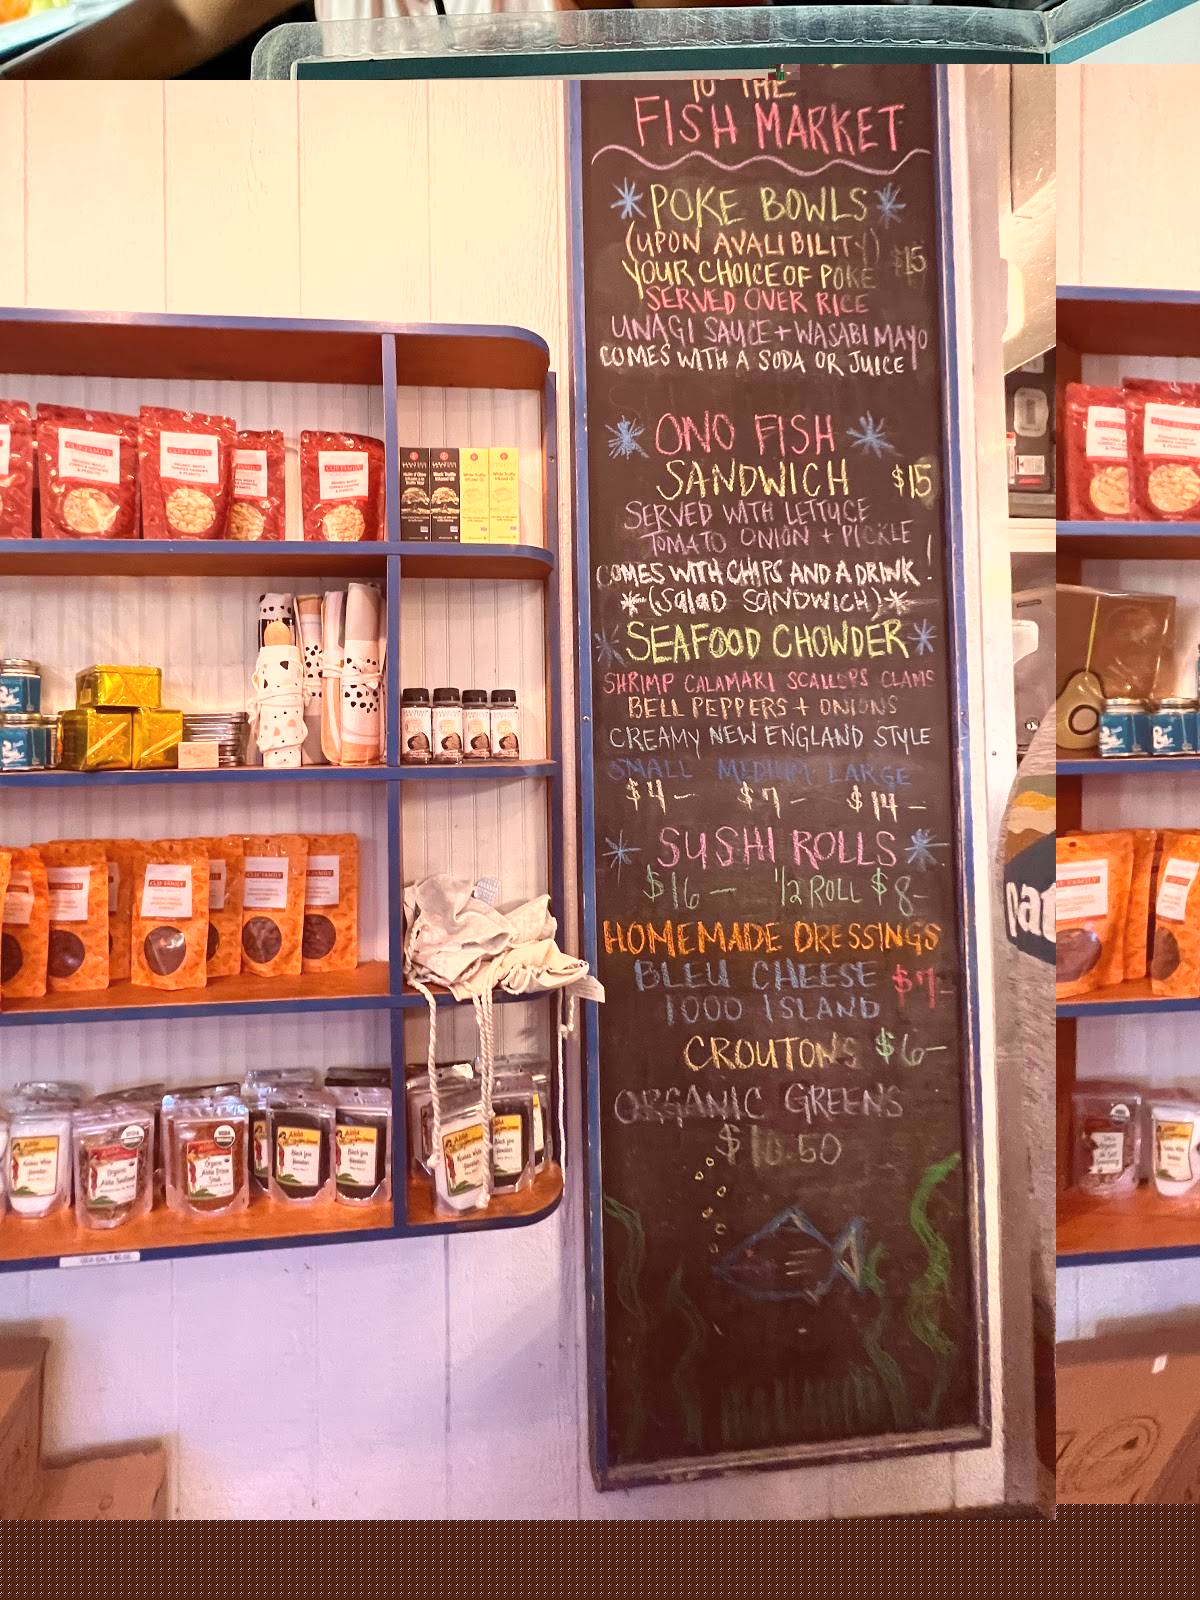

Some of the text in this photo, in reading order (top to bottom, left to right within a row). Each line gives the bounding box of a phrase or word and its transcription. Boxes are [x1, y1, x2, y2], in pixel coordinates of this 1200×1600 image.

[634, 95, 905, 156] FISH MARKET
[650, 183, 868, 230] POKE BOWLS
[625, 220, 701, 262] (UPON
[621, 259, 878, 300] YOUR CHOICE OF POKE
[645, 285, 871, 317] SERVED OVER RICE
[599, 344, 905, 377] COMES WITH A SODA OR JUICE
[610, 313, 696, 348] UNAGI
[703, 315, 772, 347] SAUCE
[793, 320, 870, 349] WASABI
[873, 326, 929, 372] MAYO
[655, 410, 836, 457] ONO FISH
[655, 458, 934, 501] SANDWICH $15
[623, 498, 872, 531] SERVED WITH LETTUCE
[640, 529, 728, 558] TOMATO
[739, 523, 811, 551] ONION
[842, 518, 915, 550] PICKLE
[595, 562, 666, 590] COMES
[669, 557, 726, 587] WITH
[726, 553, 786, 587] CHIPS
[789, 558, 833, 585] AND
[834, 560, 853, 584] A
[626, 617, 911, 665] SEAFOOD CHOWDER
[602, 667, 936, 697] SHRIMP CALAMARI SCALLOPS CLAMS
[627, 696, 686, 721] BELL
[692, 695, 788, 720] PEPPERS
[819, 694, 899, 717] ONIONS
[608, 720, 932, 760] CREAMY NEW ENGLAND STYLE
[607, 756, 694, 781] SMALL
[827, 762, 913, 790] LARGE
[656, 826, 898, 870] SUSHI ROLLS
[810, 874, 864, 910] ROLL
[602, 920, 944, 957] HOMEMADE DRESSINGS
[634, 958, 731, 992] BLEU
[751, 958, 878, 992] CHEESE
[666, 993, 881, 1026] 1000 ISLAND
[683, 1032, 859, 1073] CROUTONS
[614, 1082, 903, 1129] ORGANIC GREENS
